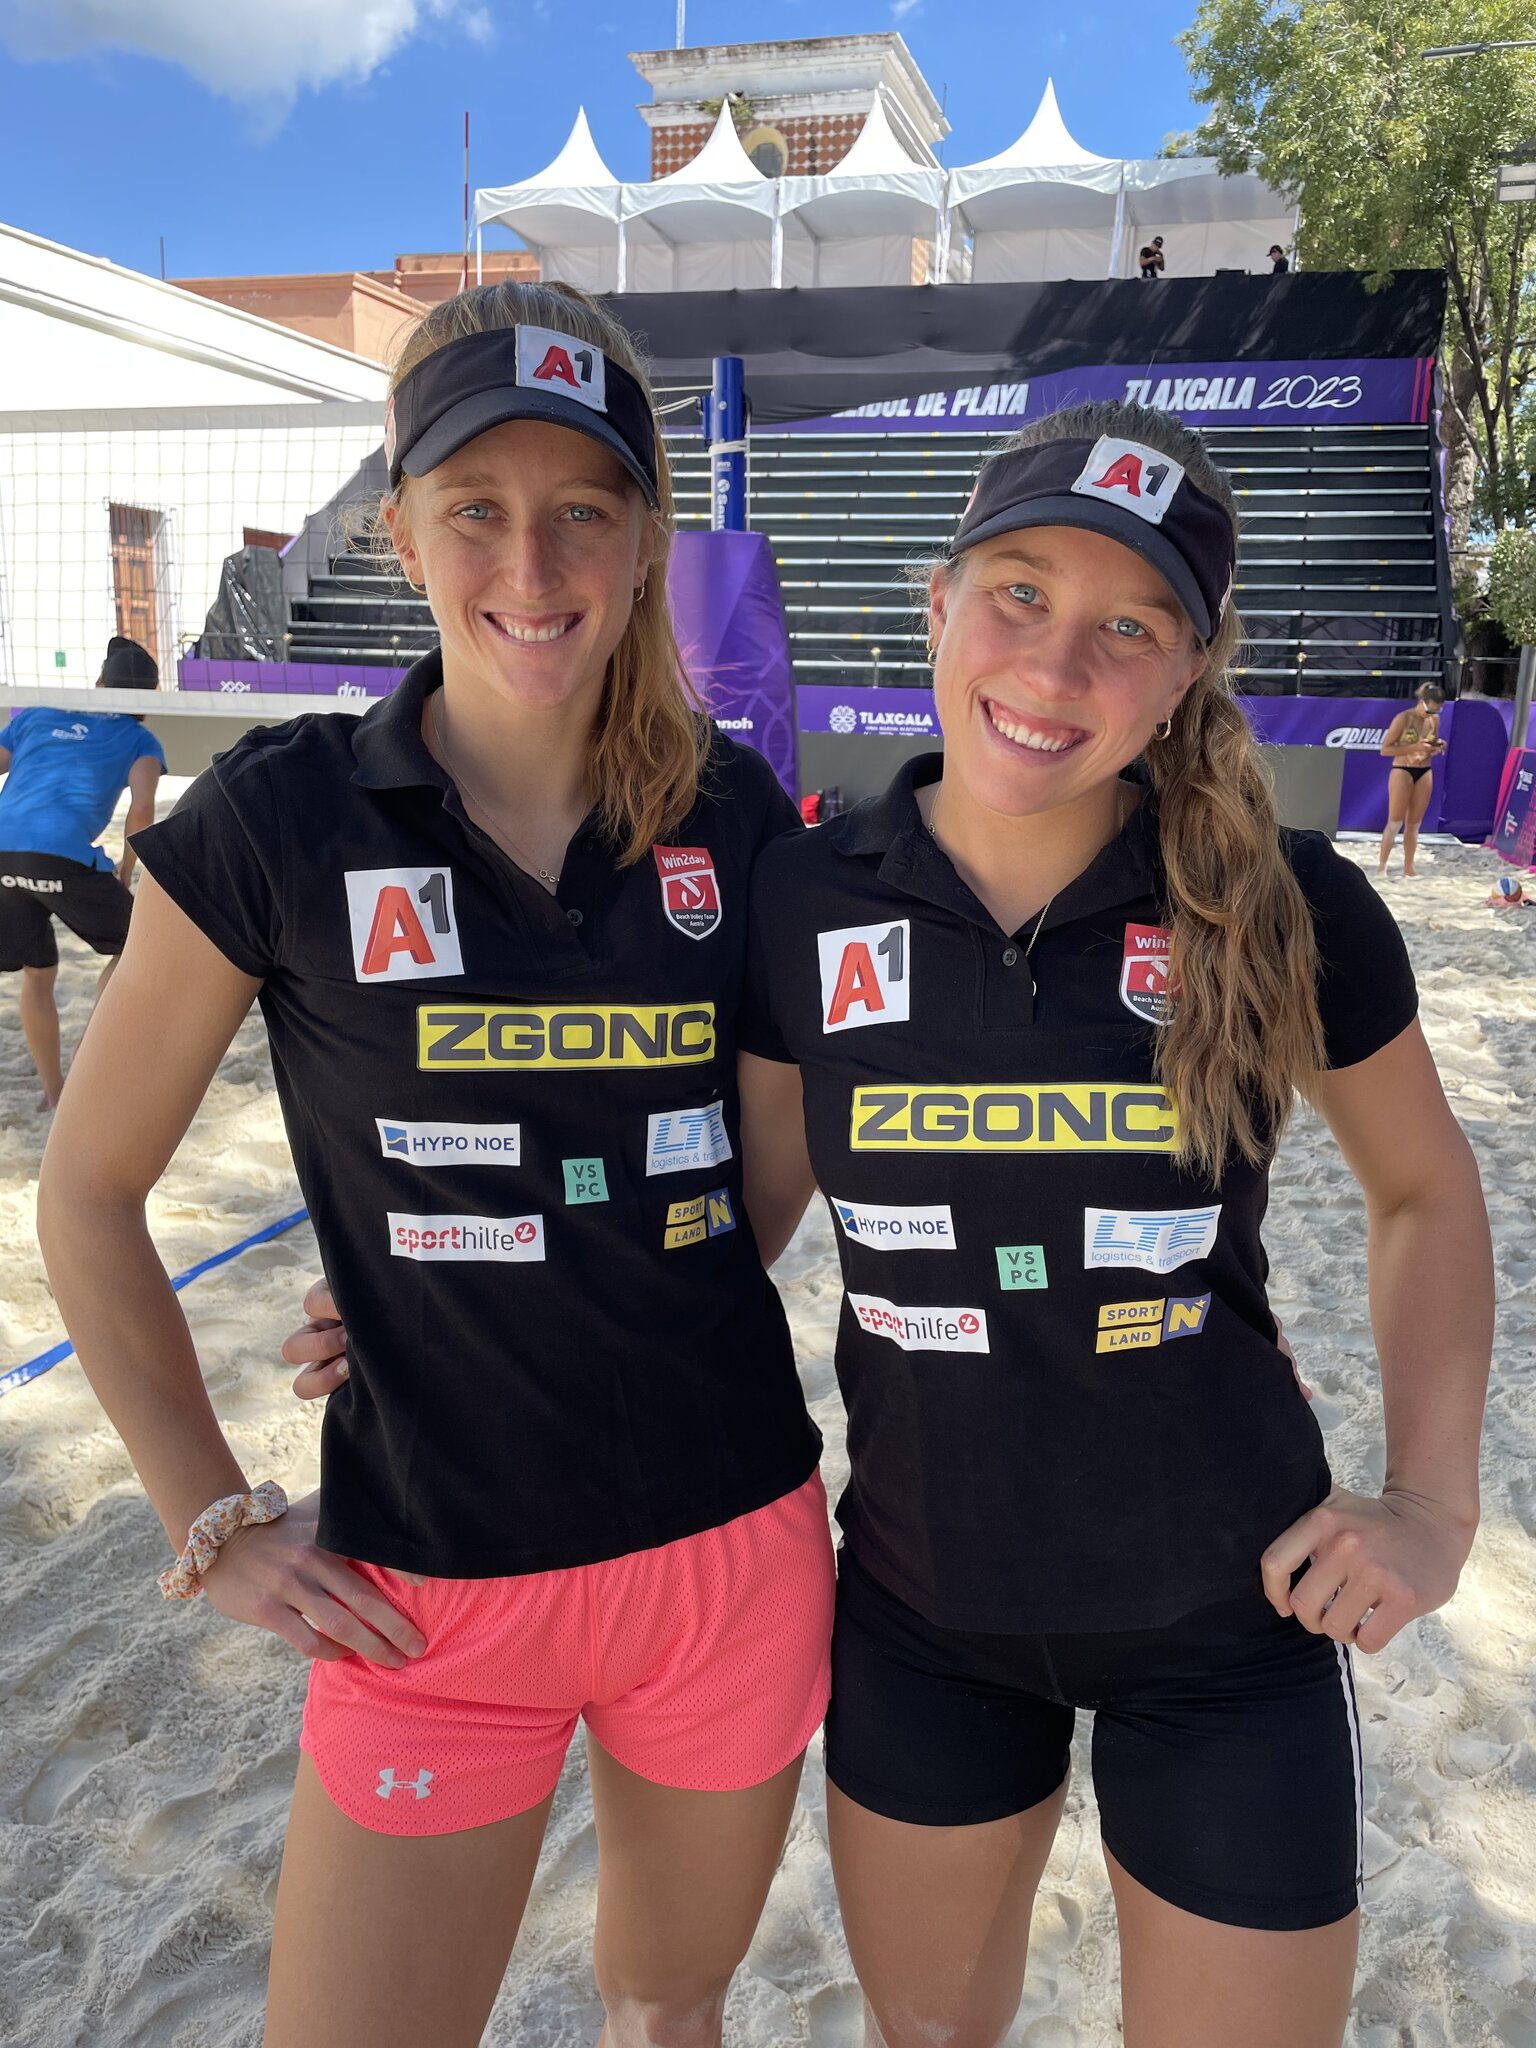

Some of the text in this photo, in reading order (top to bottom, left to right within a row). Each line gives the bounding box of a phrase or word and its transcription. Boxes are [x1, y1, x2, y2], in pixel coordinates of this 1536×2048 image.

[532, 345, 593, 388] A1
[950, 384, 1040, 417] PLAYA
[1123, 375, 1363, 411] TLAXCALA 2023
[1091, 453, 1169, 498] A1
[859, 711, 934, 727] TLAXCALA
[0, 874, 63, 893] ORLEN
[361, 872, 451, 976] A1
[827, 925, 904, 1026] A1
[1133, 995, 1152, 1004] Beach
[427, 1010, 712, 1061] ZGONC
[857, 1091, 1175, 1142] ZGONC
[413, 1136, 515, 1152] HYPO NOE
[651, 1154, 689, 1169] logistics
[692, 1152, 700, 1162] &
[572, 1165, 597, 1179] VS
[576, 1182, 599, 1198] PC
[674, 1202, 703, 1218] SPORT
[674, 1227, 701, 1242] LAND
[858, 1217, 948, 1235] HYPO NOE
[1093, 1212, 1215, 1252] LTE
[396, 1226, 514, 1253] sporthilfe
[1007, 1252, 1035, 1265] VS
[1091, 1246, 1200, 1267] logistics & transport
[1011, 1269, 1039, 1284] PC
[1107, 1306, 1159, 1321] SPORT
[858, 1306, 959, 1341] sporthilfe
[1110, 1330, 1152, 1346] LAND
